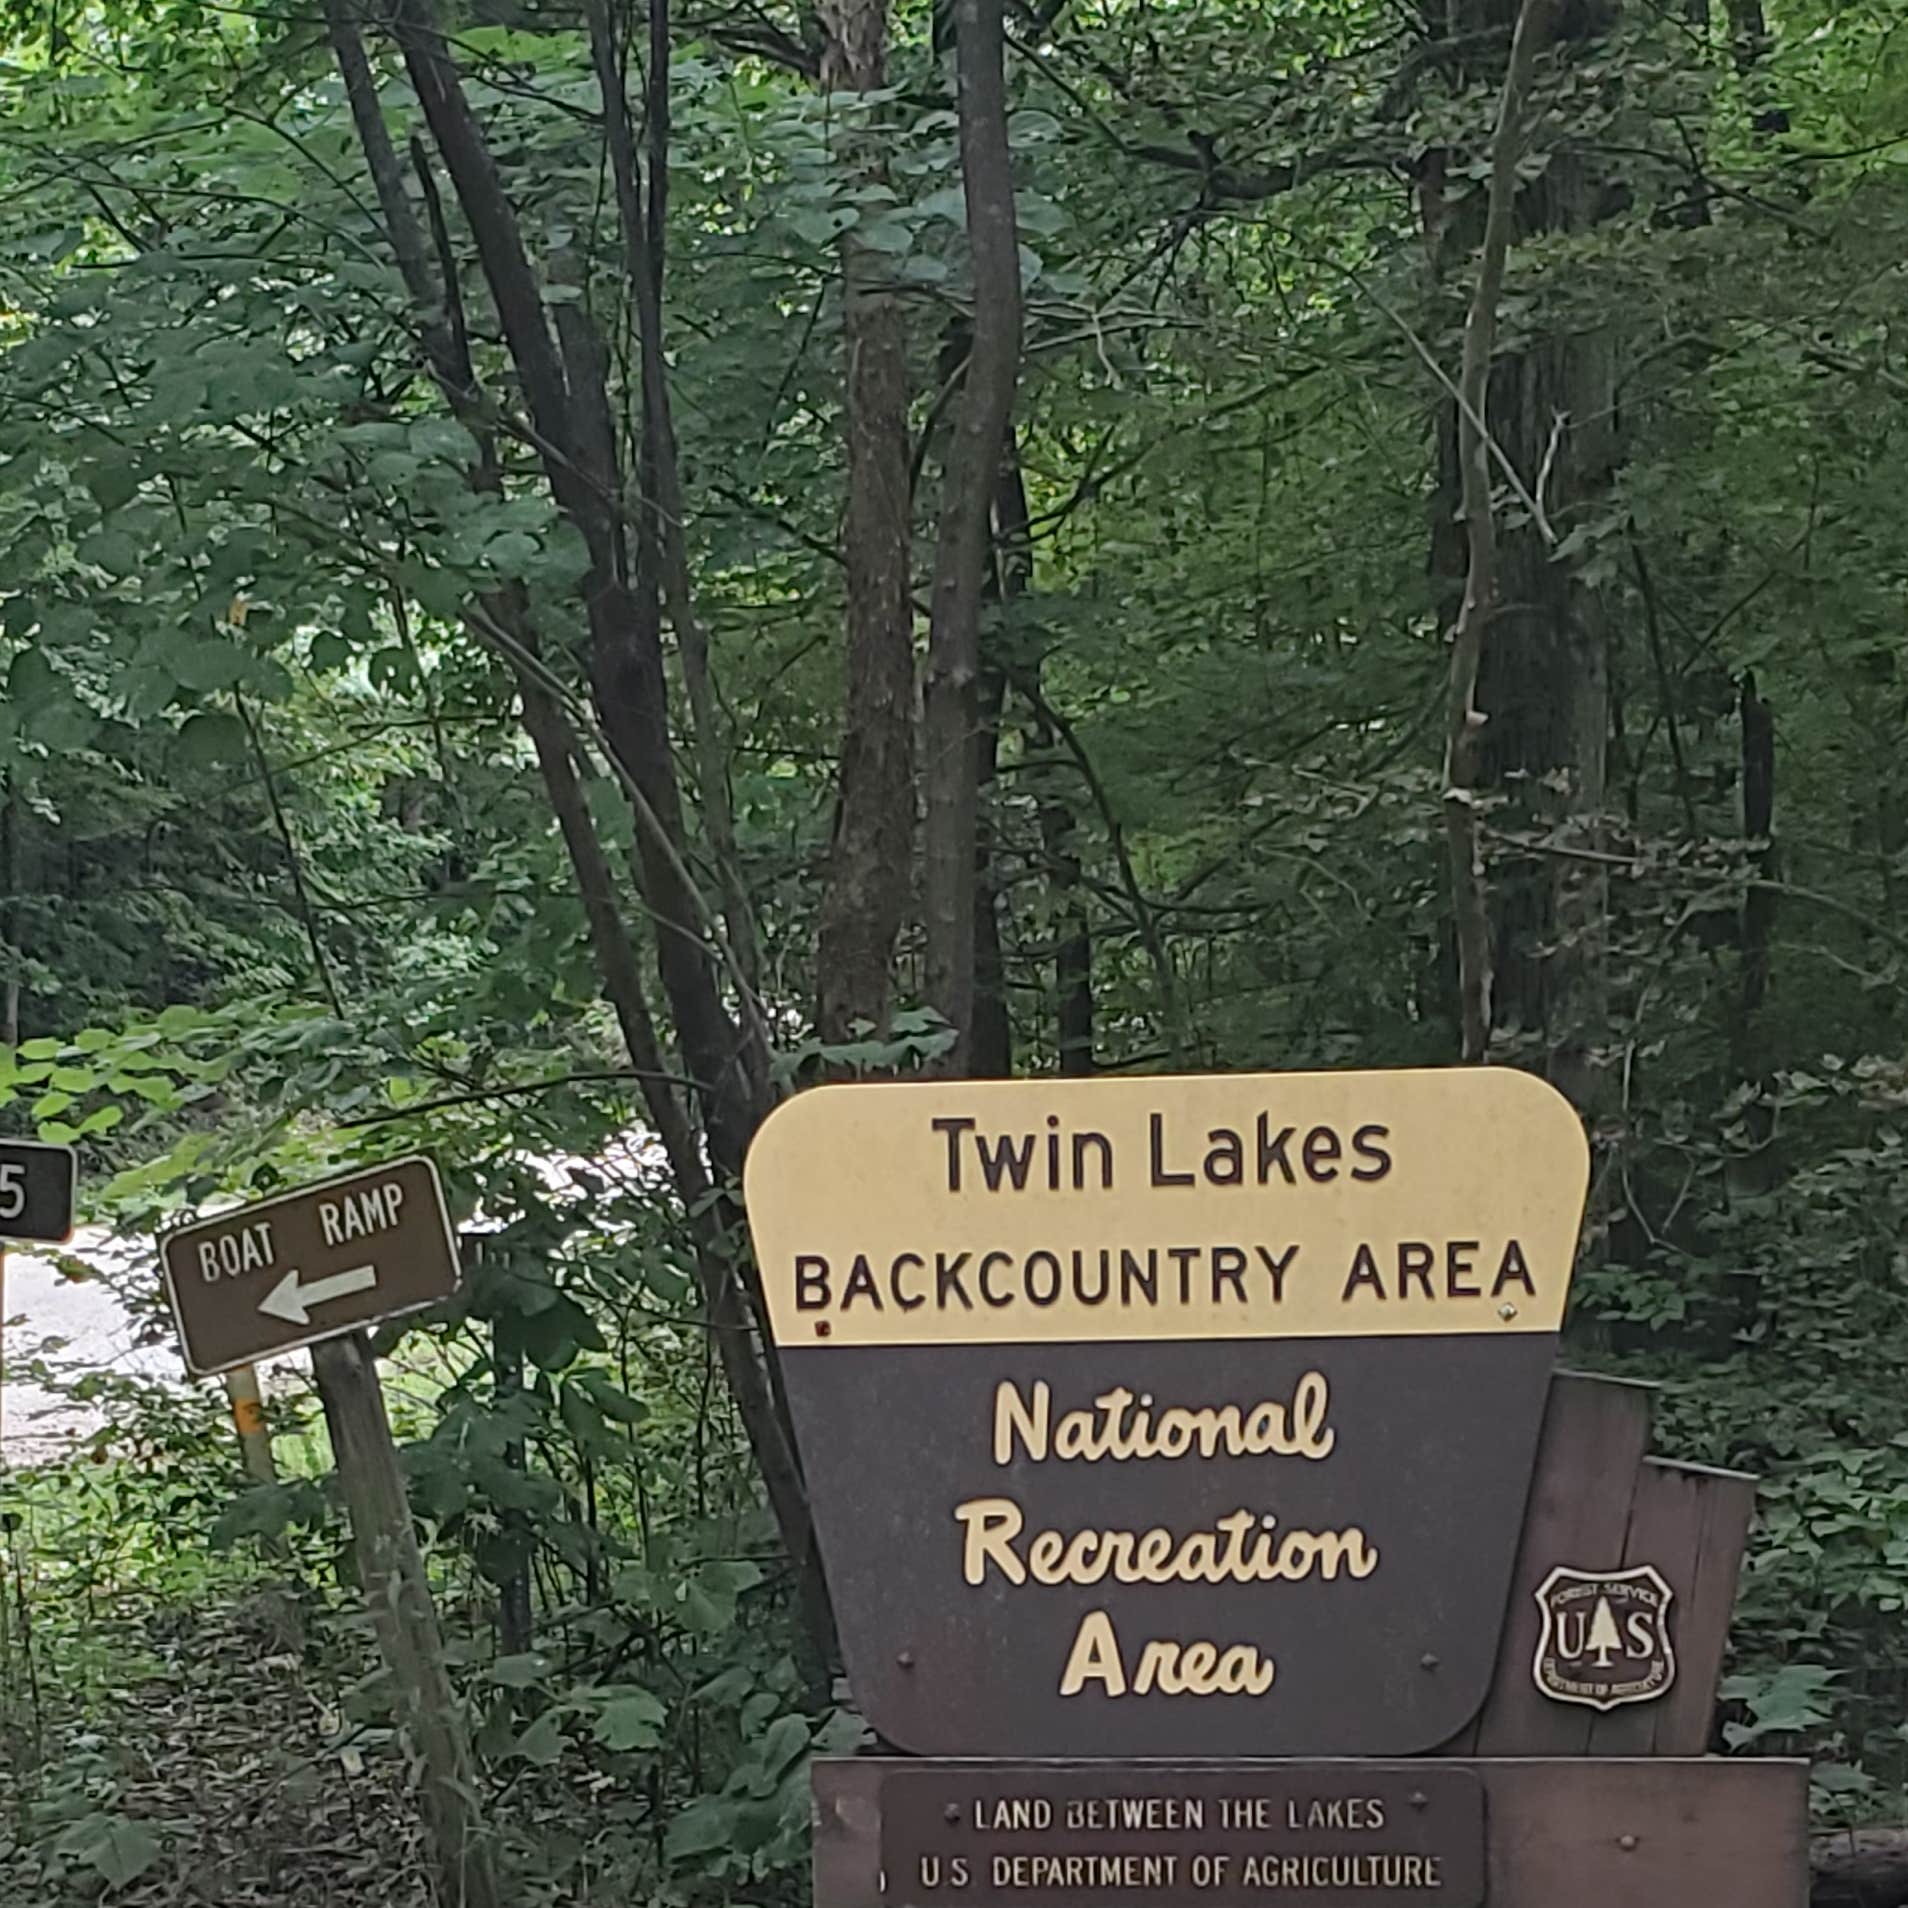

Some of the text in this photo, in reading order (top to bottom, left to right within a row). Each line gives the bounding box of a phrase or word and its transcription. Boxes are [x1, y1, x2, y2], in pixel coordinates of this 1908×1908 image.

[0, 1163, 26, 1219] 5
[931, 1110, 1393, 1193] Twin Lakes
[198, 1182, 404, 1284] BOAT RAMP
[794, 1239, 1537, 1312] BACKCOUNTRY AREA
[993, 1370, 1336, 1465] National
[954, 1498, 1378, 1586] Recreation
[1058, 1610, 1275, 1698] Area
[974, 1799, 1386, 1830] LAND BETWEEN THE LAKES
[992, 1855, 1178, 1887] DEPARTMENT
[1191, 1855, 1230, 1887] OF
[1242, 1854, 1442, 1887] AGRICULTURE
